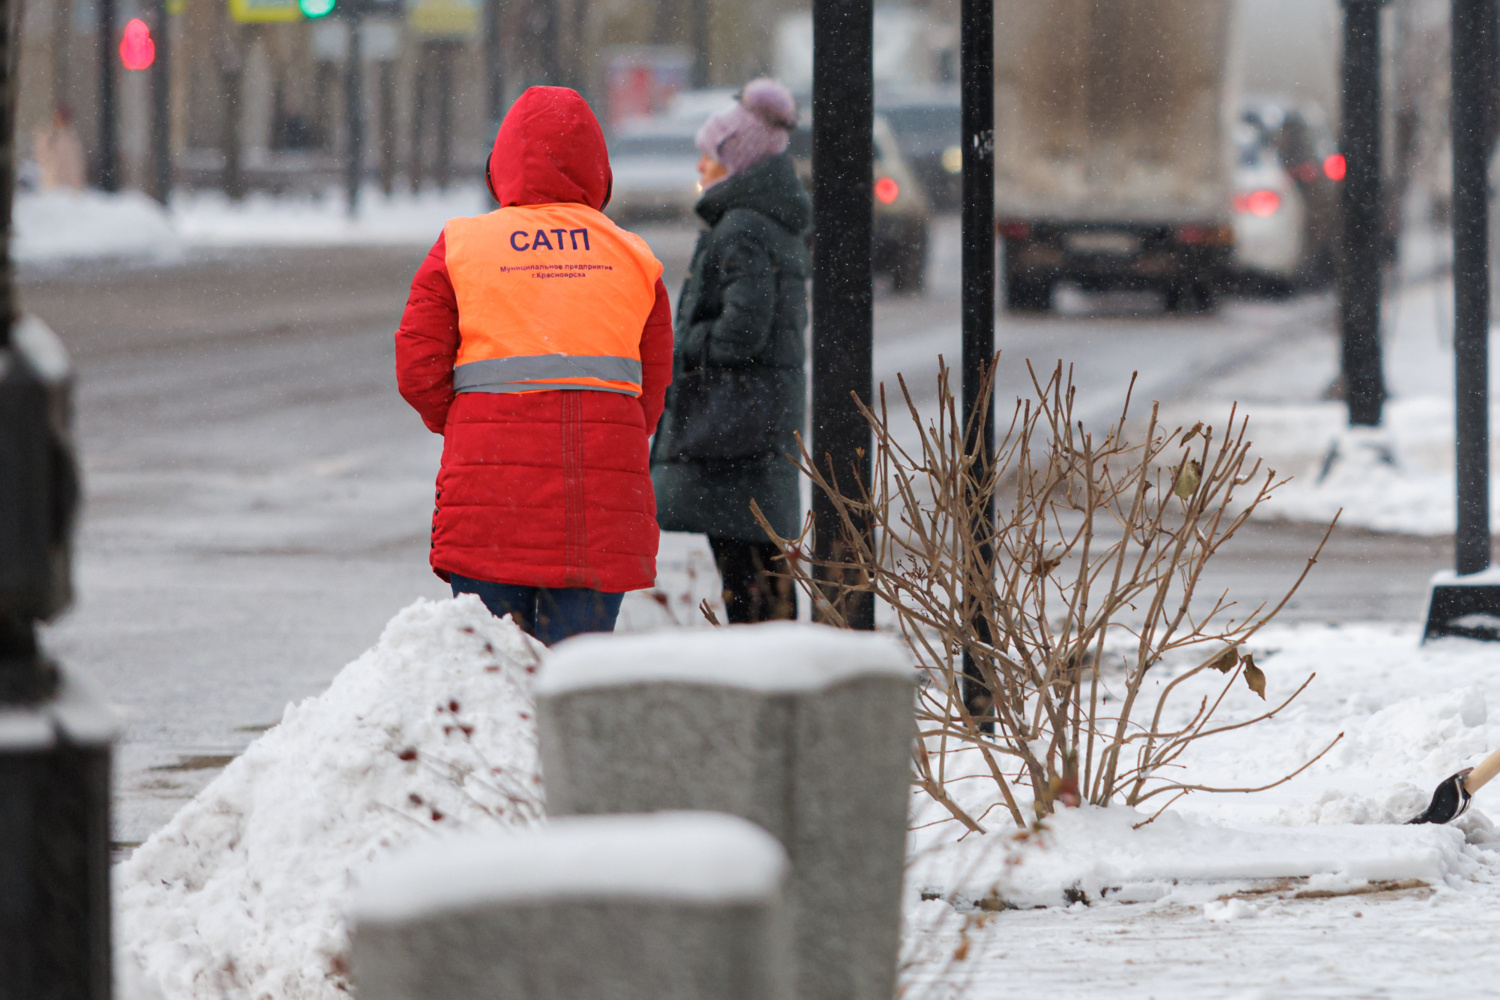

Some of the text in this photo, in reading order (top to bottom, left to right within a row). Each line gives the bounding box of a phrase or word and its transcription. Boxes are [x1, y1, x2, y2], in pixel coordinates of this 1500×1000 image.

[510, 228, 590, 252] САТП
[500, 264, 613, 273] Муниципальное предприятие
